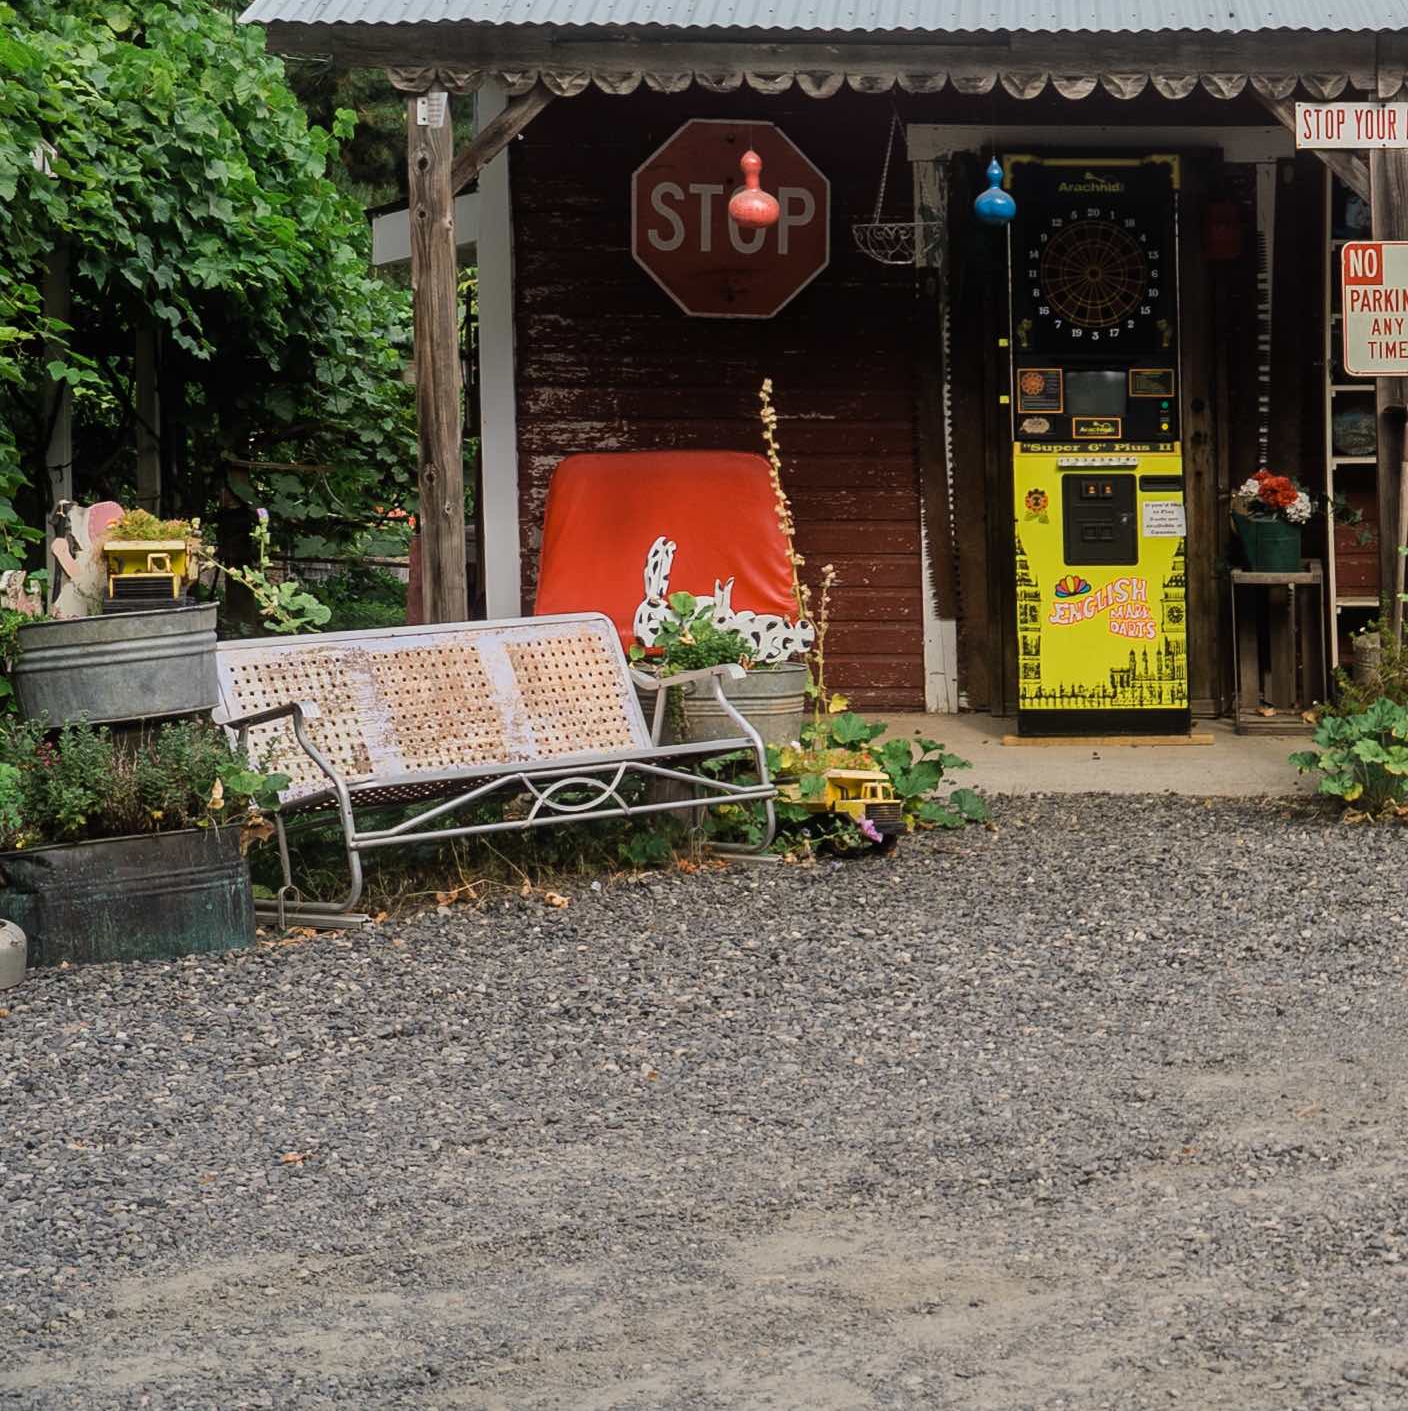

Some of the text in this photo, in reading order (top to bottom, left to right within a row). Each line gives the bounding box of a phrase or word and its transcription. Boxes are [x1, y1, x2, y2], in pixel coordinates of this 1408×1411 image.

[1303, 109, 1345, 140] STOP
[1355, 109, 1397, 140] YOUR
[1058, 181, 1124, 192] Arachnid
[648, 181, 816, 255] STOP
[1070, 210, 1078, 220] 5
[1087, 208, 1100, 218] 20
[1110, 210, 1116, 220] 1
[1051, 217, 1063, 227] 12
[1124, 218, 1136, 228] 18
[1040, 233, 1048, 242] 9
[1139, 233, 1147, 243] 4
[1028, 250, 1039, 259] 14
[1148, 250, 1159, 259] 13
[1349, 248, 1378, 278] NO
[1028, 269, 1037, 278] 11
[1151, 269, 1158, 278] 6
[1032, 288, 1040, 297] 8
[1148, 288, 1159, 297] 10
[1039, 306, 1050, 315] 16
[1140, 306, 1151, 315] 15
[1055, 320, 1063, 329] 7
[1127, 320, 1135, 329] 2
[1371, 318, 1405, 336] ANY
[1071, 328, 1082, 338] 19
[1091, 331, 1099, 340] 3
[1109, 328, 1120, 338] 17
[1368, 341, 1408, 359] TIME
[1114, 443, 1150, 451] Plus
[1049, 577, 1148, 625] ENGLISH
[1109, 620, 1156, 639] DARTS
